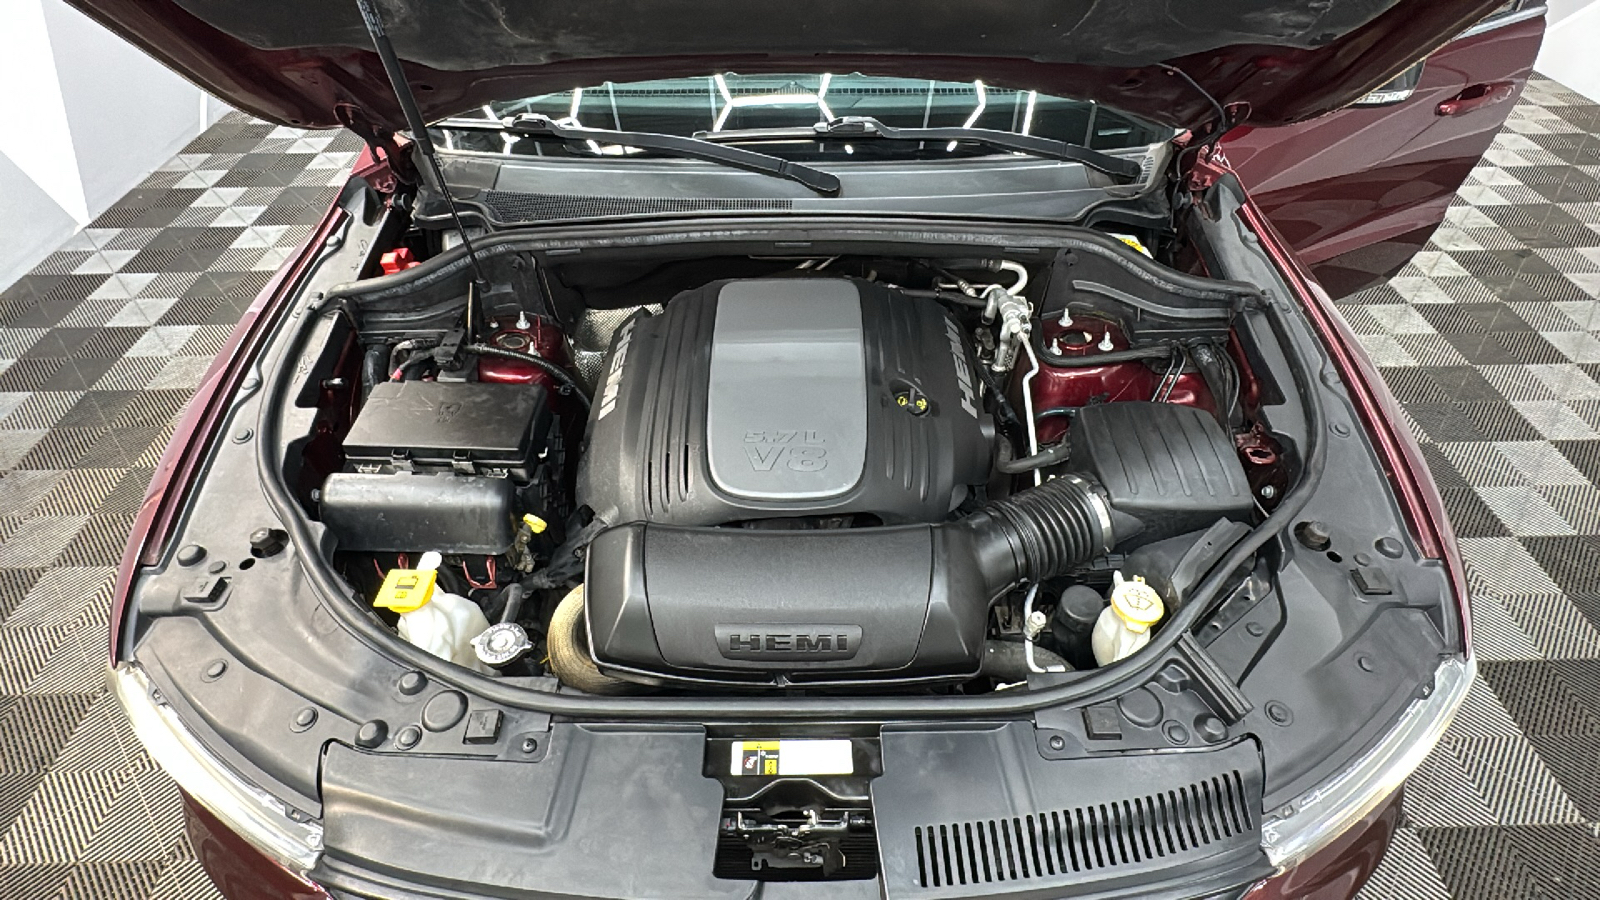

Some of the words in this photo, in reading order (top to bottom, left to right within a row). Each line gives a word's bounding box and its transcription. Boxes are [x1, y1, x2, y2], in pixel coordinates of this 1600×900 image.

[598, 318, 636, 421] HEMI
[944, 316, 978, 419] HEMI
[743, 446, 828, 472] V8
[729, 634, 848, 652] HEMI
